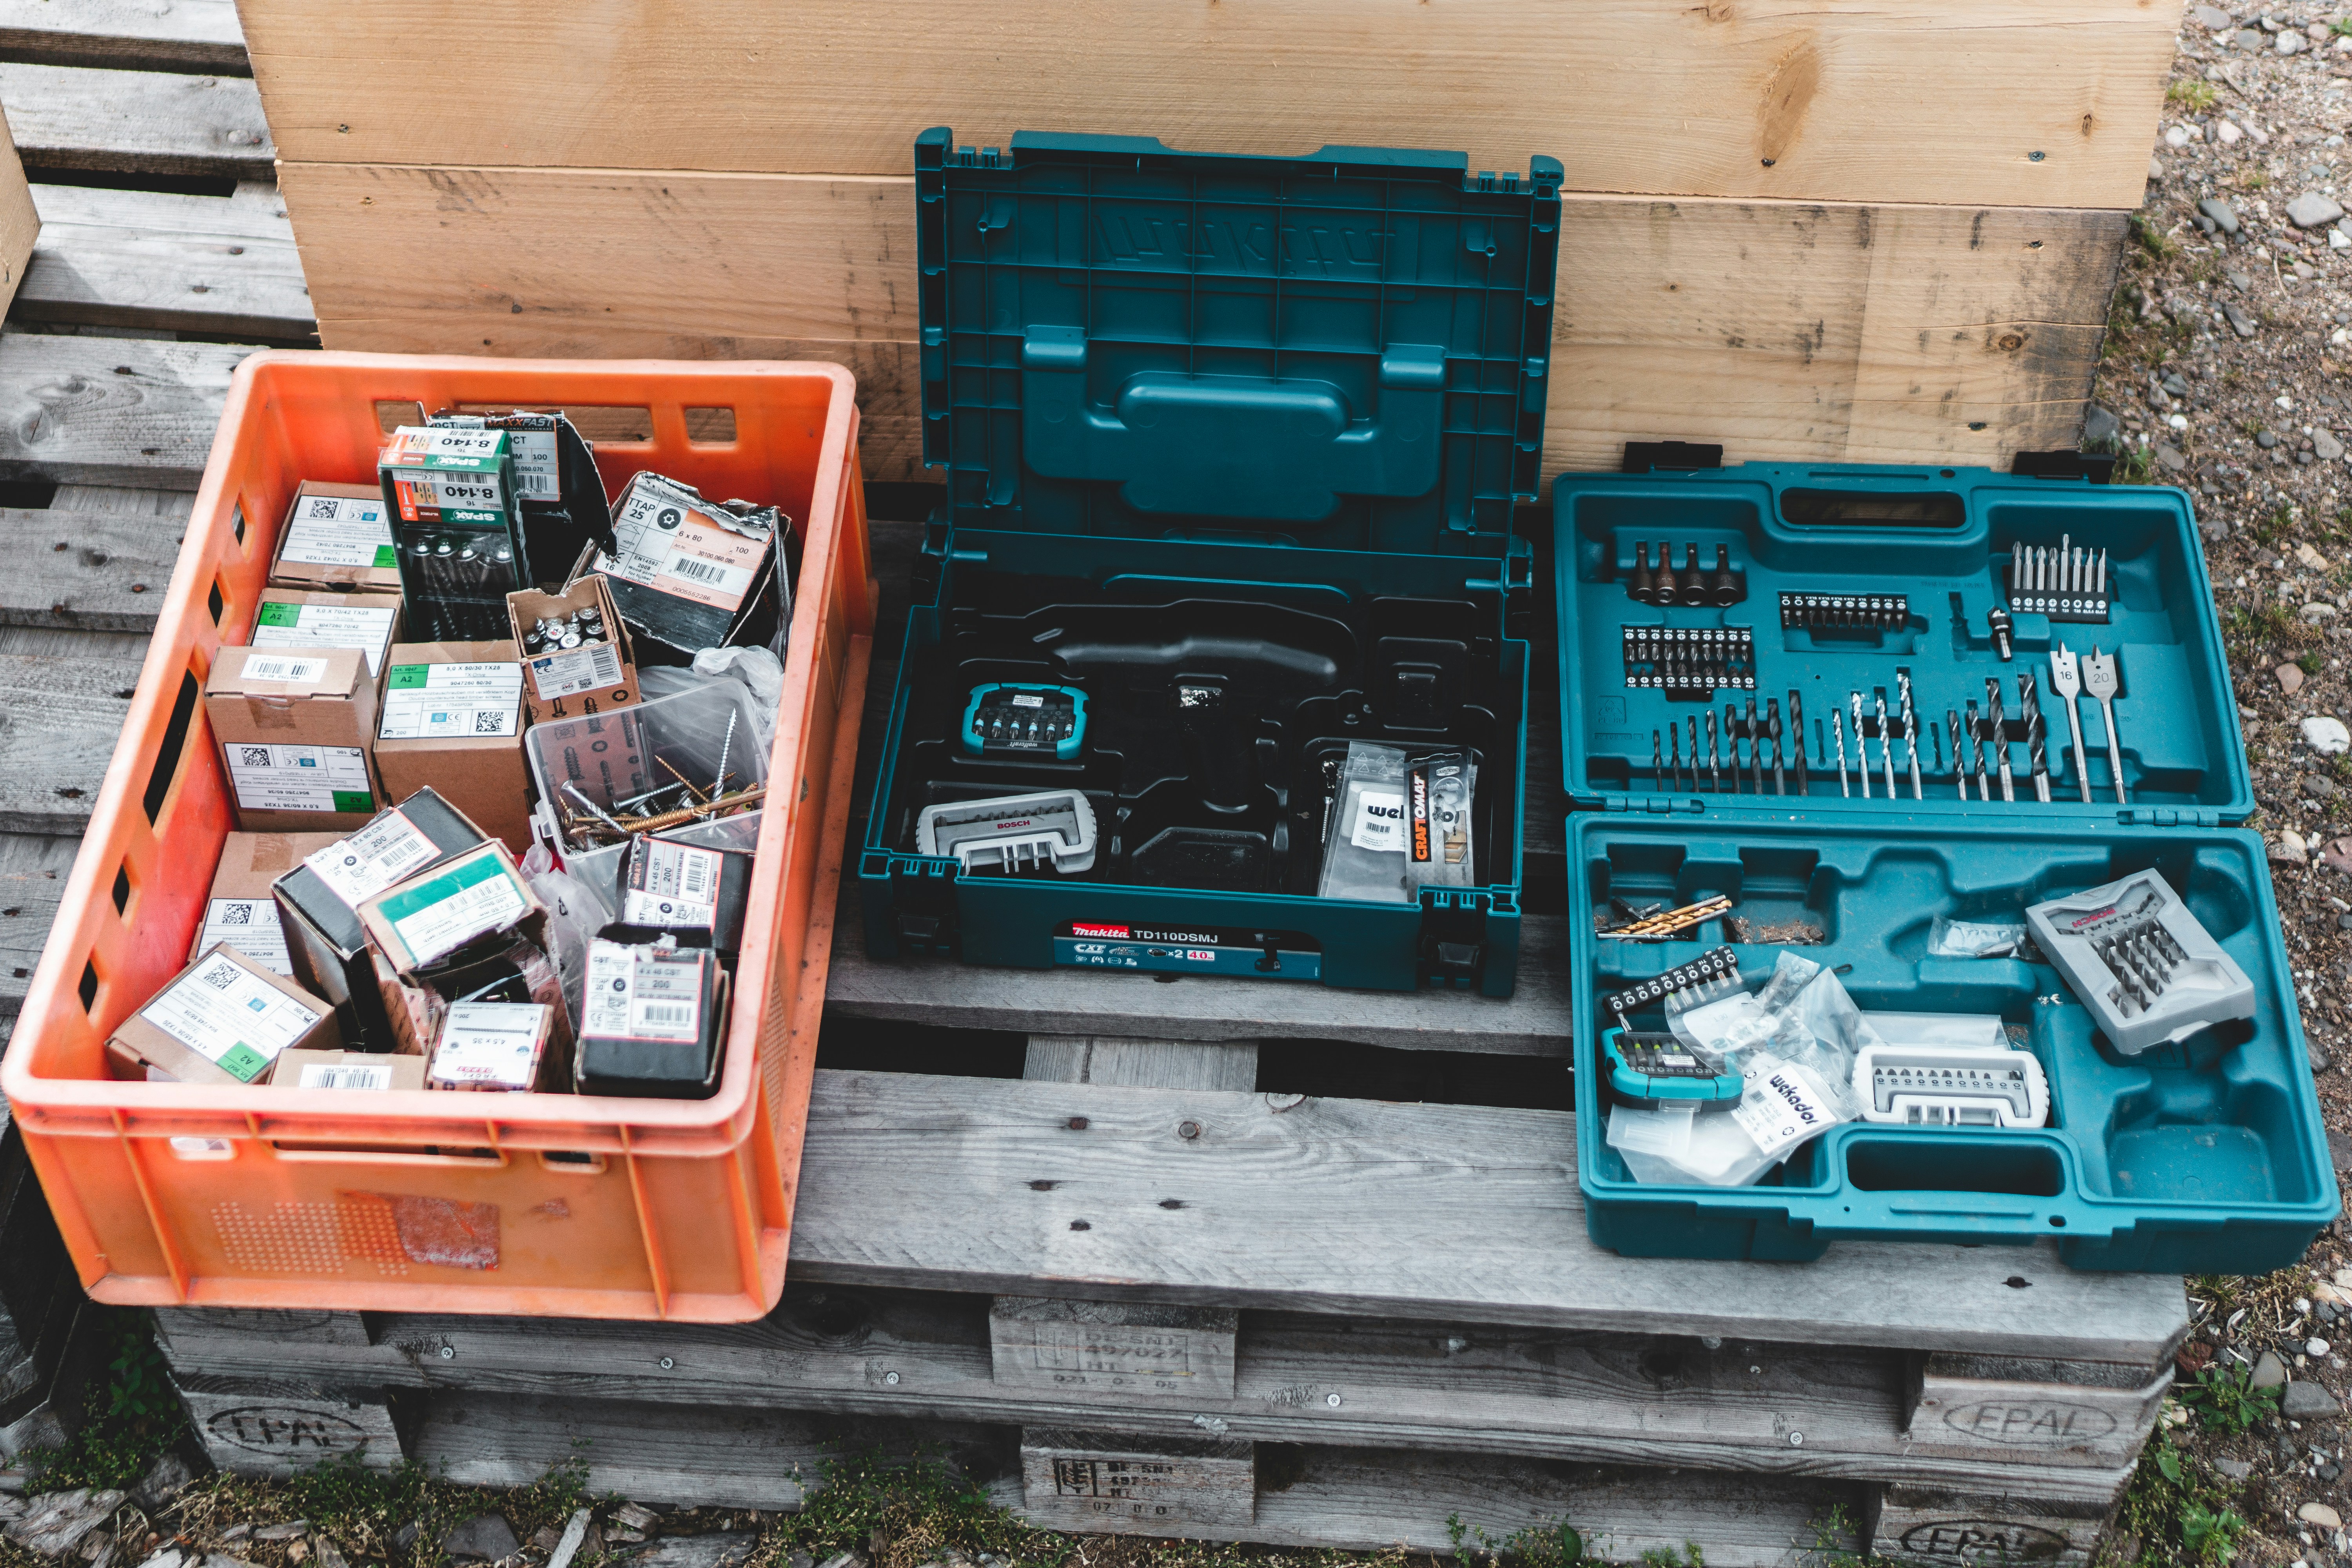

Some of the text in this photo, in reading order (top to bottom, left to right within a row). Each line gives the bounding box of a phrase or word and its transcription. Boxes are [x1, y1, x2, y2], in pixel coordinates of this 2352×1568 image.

[437, 456, 481, 466] SPAX
[628, 497, 655, 512] TTAP
[454, 512, 495, 521] SPAX
[630, 510, 644, 520] 25
[698, 550, 735, 564] 30100.060.080
[604, 563, 615, 571] 16
[672, 586, 711, 601] 0005552286
[2059, 670, 2072, 681] 16
[2093, 673, 2109, 683] 20
[1414, 774, 1428, 860] CRAFTOMAT
[372, 822, 385, 833] CST
[997, 820, 1030, 829] BOSCH
[371, 835, 387, 848] 200
[663, 867, 672, 882] 200
[2072, 907, 2116, 927] BOSCH
[1134, 930, 1218, 943] TD110DSMJ
[1074, 943, 1106, 954] CXT
[652, 980, 670, 988] 200
[163, 1019, 177, 1031] TX20
[240, 1054, 253, 1066] A2
[1770, 1074, 1819, 1125] wekador
[1972, 1405, 2088, 1436] EPAL
